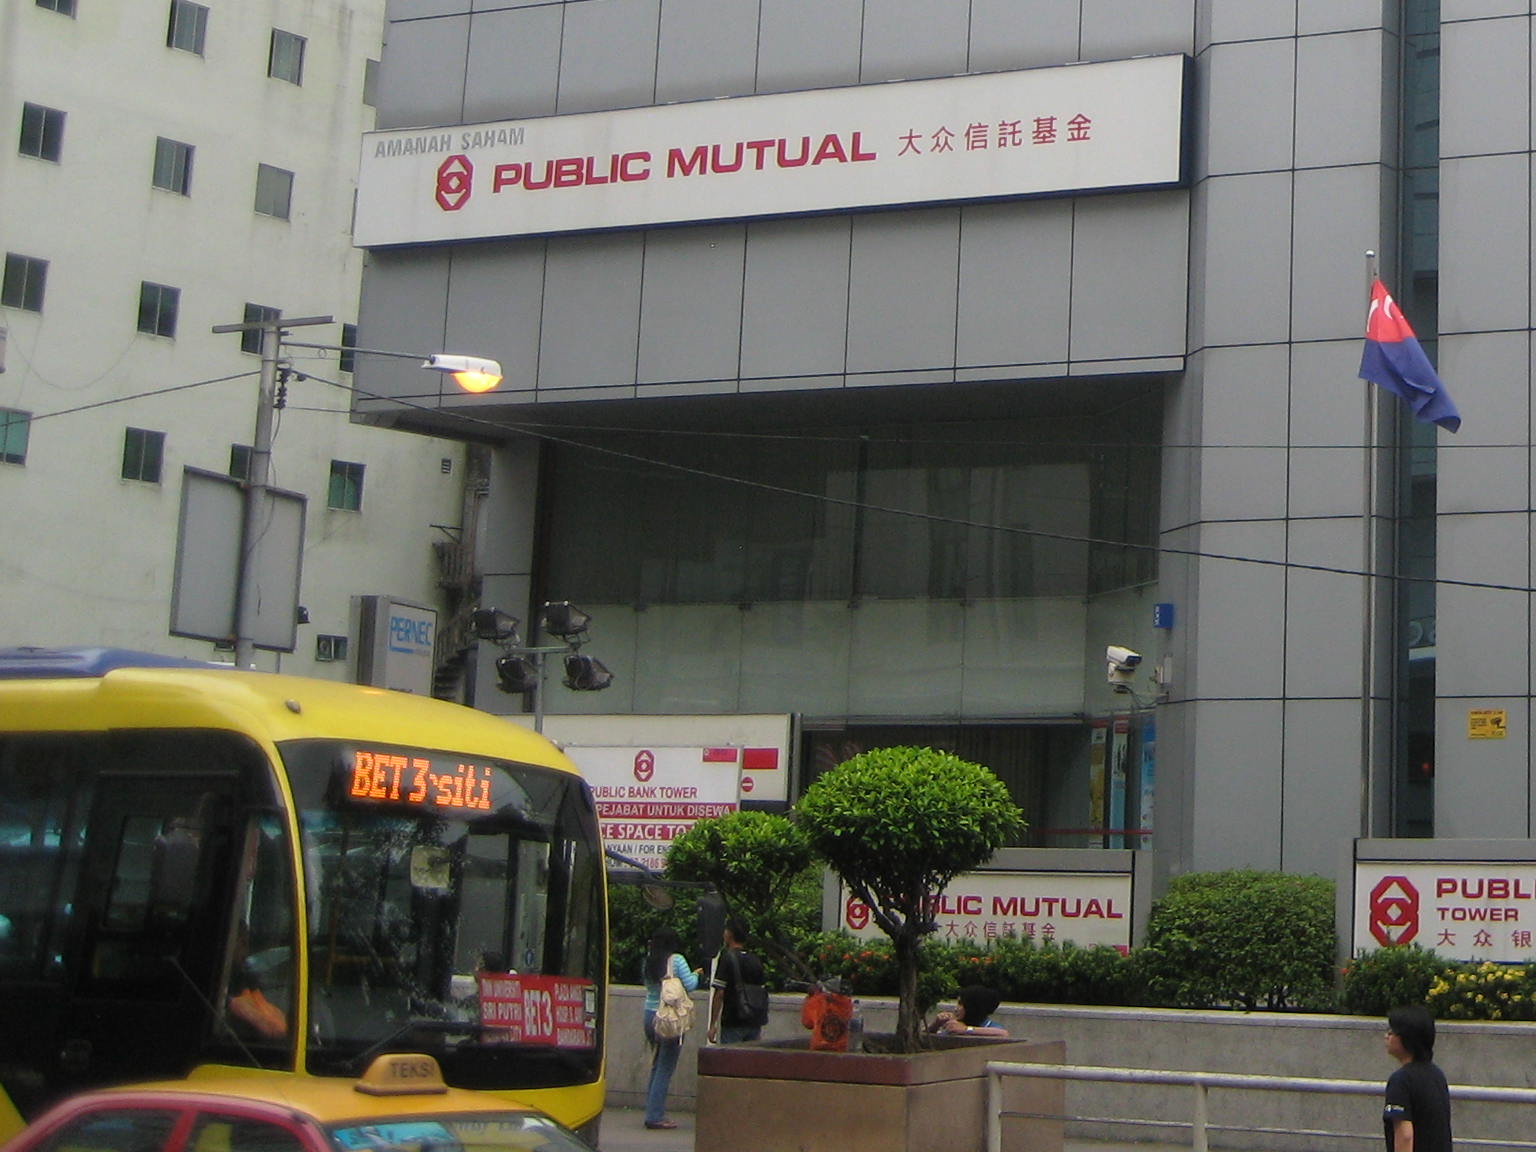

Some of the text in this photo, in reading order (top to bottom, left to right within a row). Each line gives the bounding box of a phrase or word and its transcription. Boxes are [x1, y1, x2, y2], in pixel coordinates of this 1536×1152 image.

[375, 127, 525, 158] AMANAH SAHAM
[492, 112, 1094, 195] PUBLIC MUTUAL 大众信託基金
[351, 751, 409, 800] BET
[628, 786, 656, 798] BANK
[659, 786, 698, 799] TOWER
[647, 803, 684, 817] UNTUK
[687, 804, 731, 818] DISEWA
[617, 824, 664, 840] SPACE
[639, 844, 655, 854] FOR
[886, 895, 1123, 919] BLIC MUTUAL
[1437, 907, 1519, 922] TOWER
[391, 1062, 435, 1078] TEKSI
